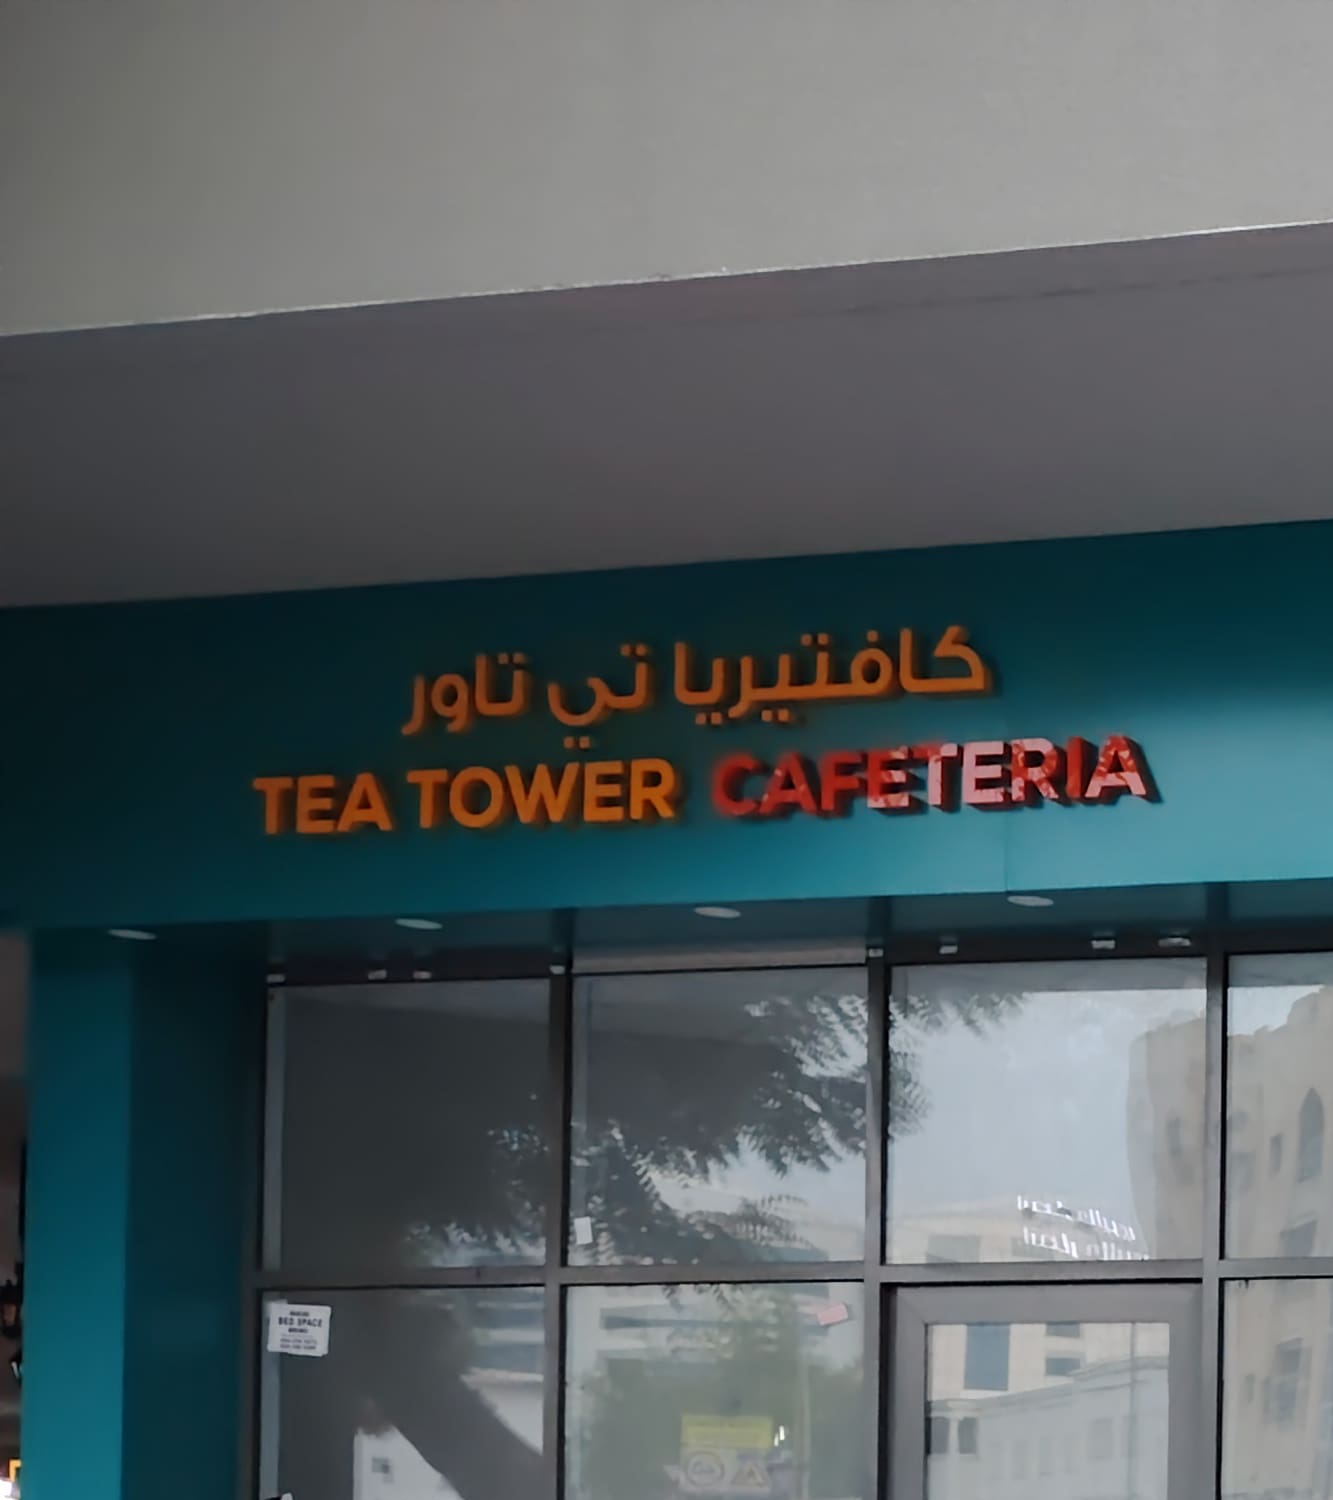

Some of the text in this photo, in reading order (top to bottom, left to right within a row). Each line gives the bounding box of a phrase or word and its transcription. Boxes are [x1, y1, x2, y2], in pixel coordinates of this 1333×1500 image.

[402, 624, 991, 749] كافتيريا تي تاور
[252, 734, 1150, 835] TEA TOWER CAFETERIA
